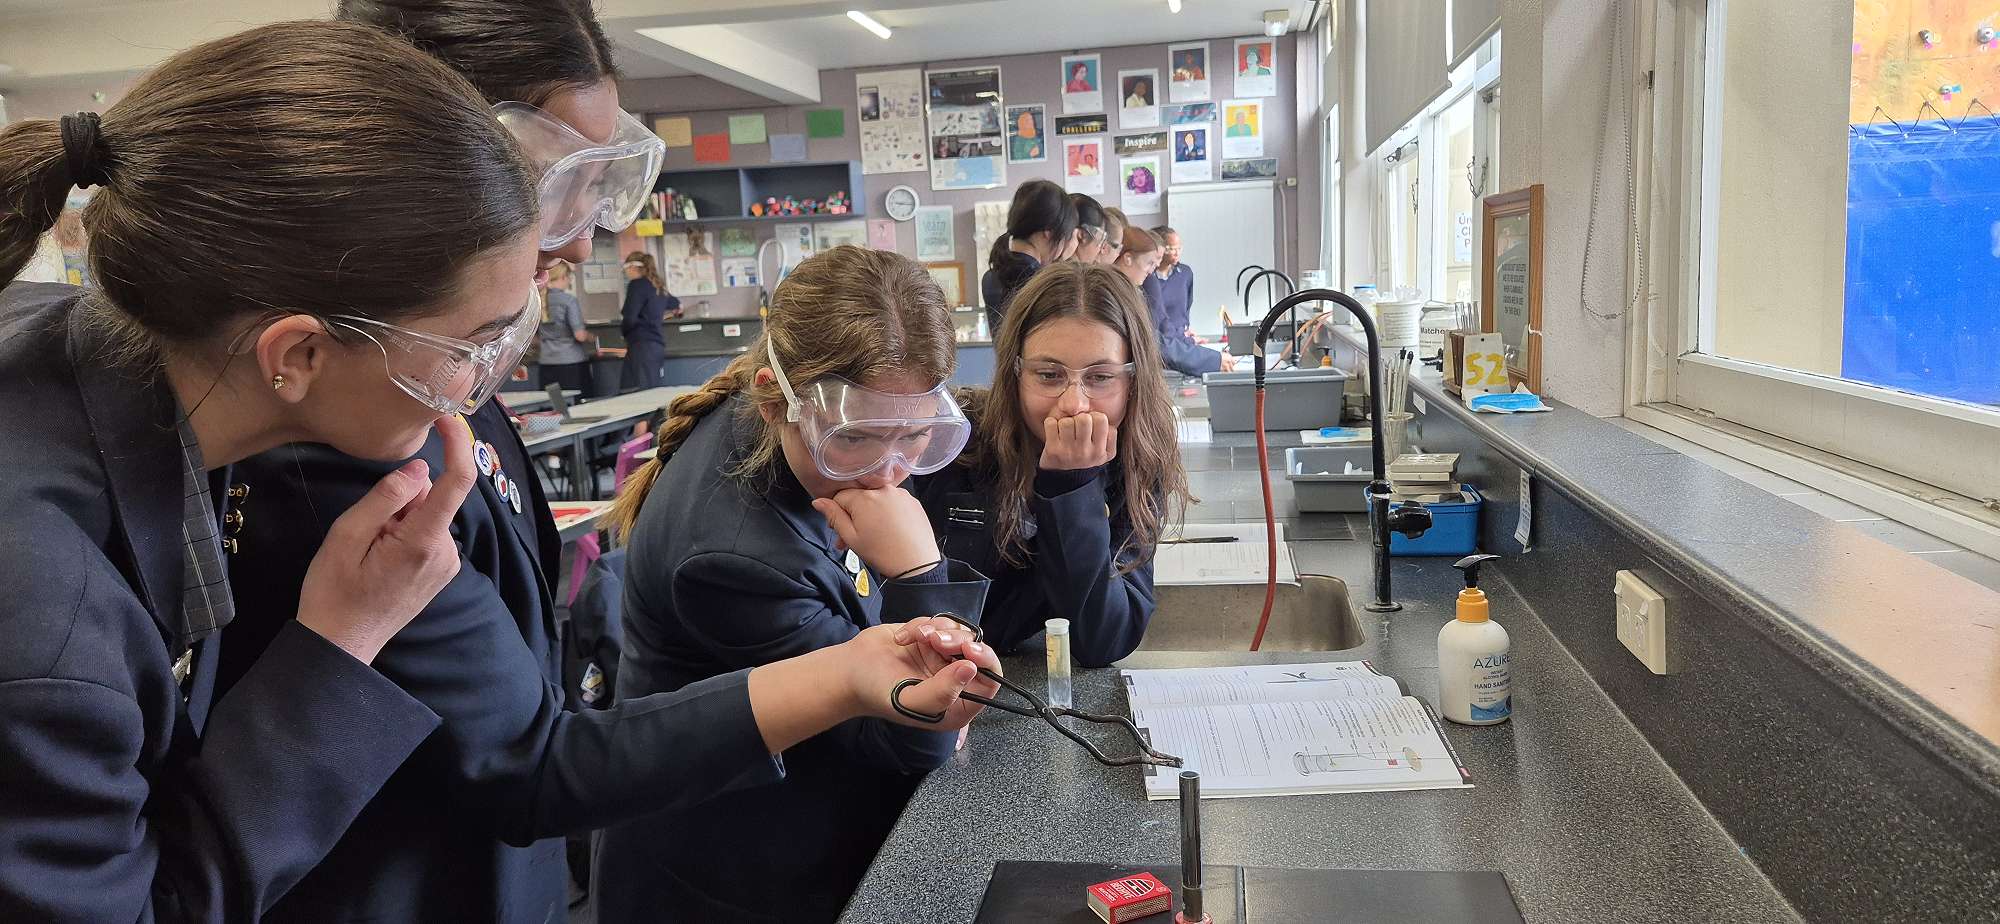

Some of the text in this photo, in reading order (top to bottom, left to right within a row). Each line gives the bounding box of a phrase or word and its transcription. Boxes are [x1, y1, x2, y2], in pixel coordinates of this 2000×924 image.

[1124, 137, 1157, 148] Inspire
[1420, 327, 1445, 335] Matche
[1474, 682, 1491, 690] HAND
